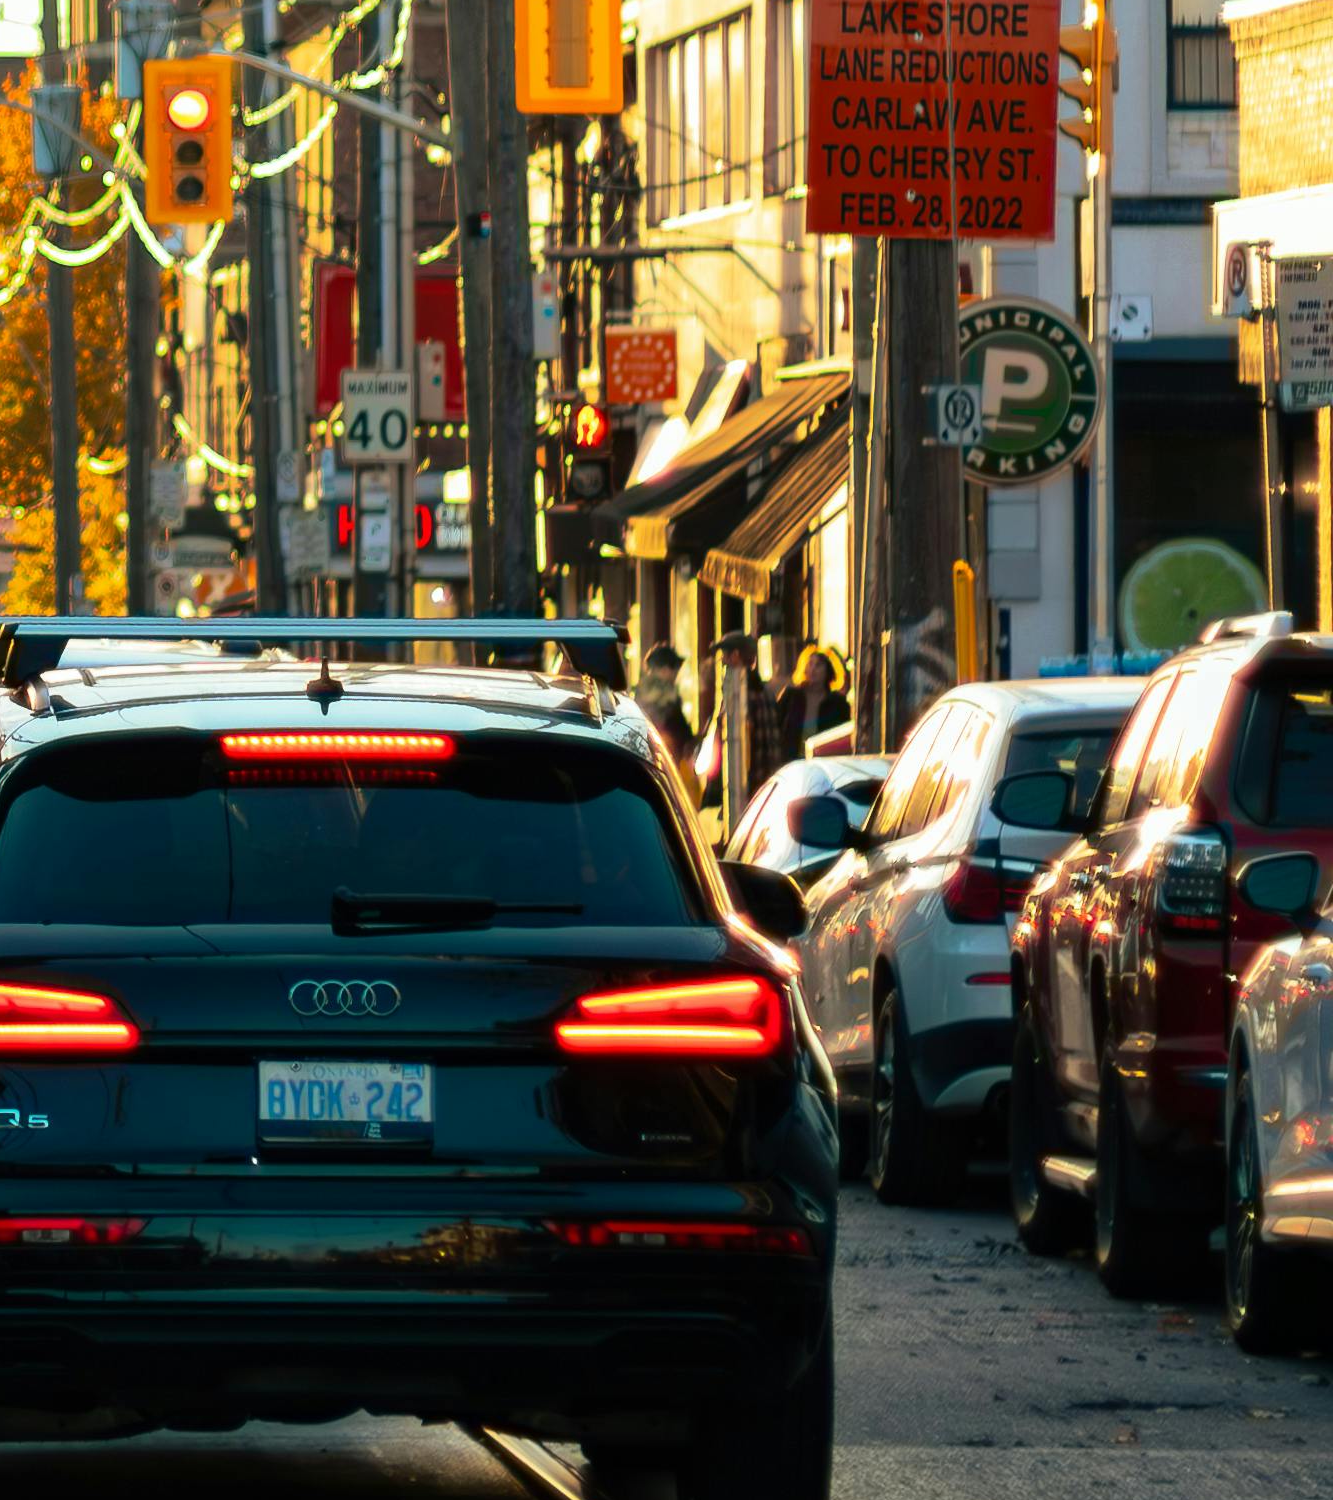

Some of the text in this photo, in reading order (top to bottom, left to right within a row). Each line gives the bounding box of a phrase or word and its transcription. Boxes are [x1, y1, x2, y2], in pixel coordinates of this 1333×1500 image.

[840, 2, 1030, 37] LAKE SHORE
[820, 48, 1050, 86] LANE REDUCTIONS
[831, 96, 1035, 135] CARLAW AVE.
[822, 143, 1042, 183] TO CHERRY ST.
[839, 192, 1023, 234] FEB. 28, 2022
[347, 381, 409, 396] MAXIMUM
[981, 346, 1049, 417] P
[347, 408, 409, 451] 40
[312, 1065, 380, 1080] ONTARIO
[365, 1080, 423, 1122] 242
